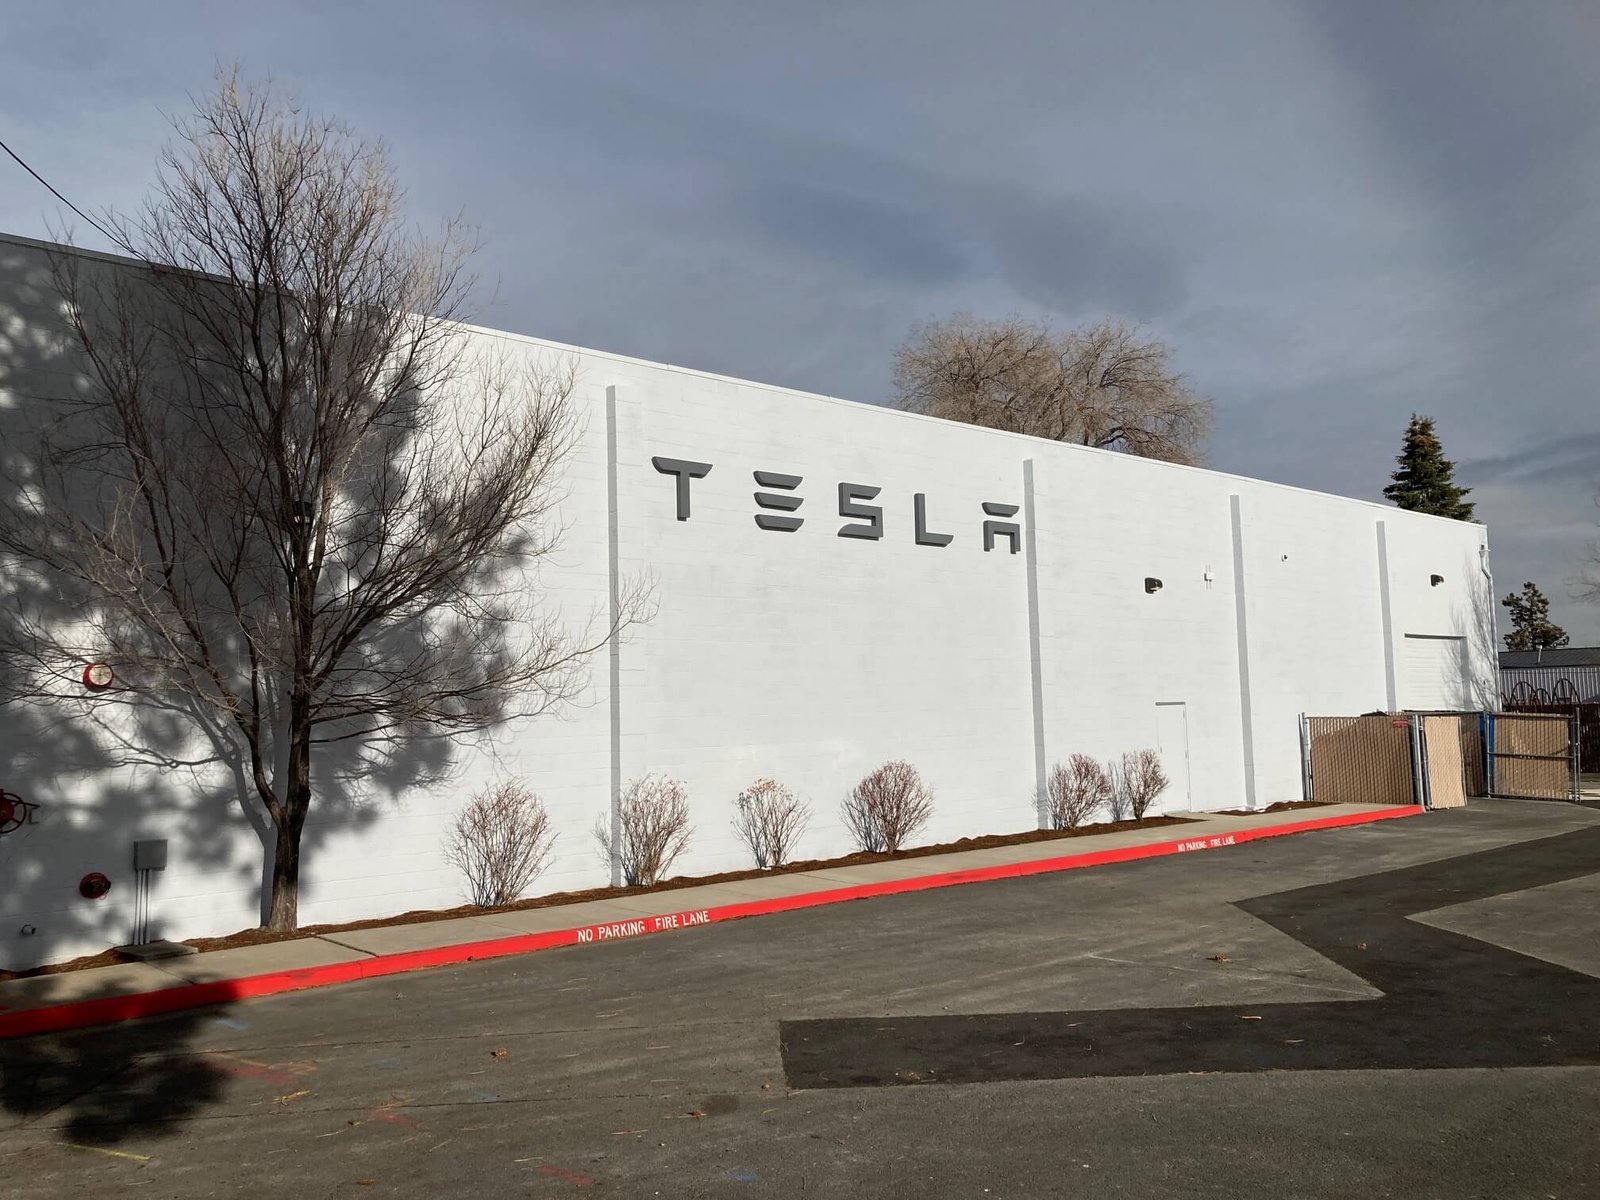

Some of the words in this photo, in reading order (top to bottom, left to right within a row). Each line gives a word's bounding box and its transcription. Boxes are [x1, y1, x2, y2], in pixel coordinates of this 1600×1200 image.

[651, 456, 1021, 555] TESLA
[1177, 844, 1185, 852] NO
[1186, 841, 1207, 851] PARKING
[1210, 838, 1221, 847] FIRE
[1222, 836, 1236, 846] LANE
[577, 930, 593, 943] NO
[598, 920, 645, 940] PARKING
[655, 915, 679, 929] FIRE
[682, 910, 710, 926] LANE
